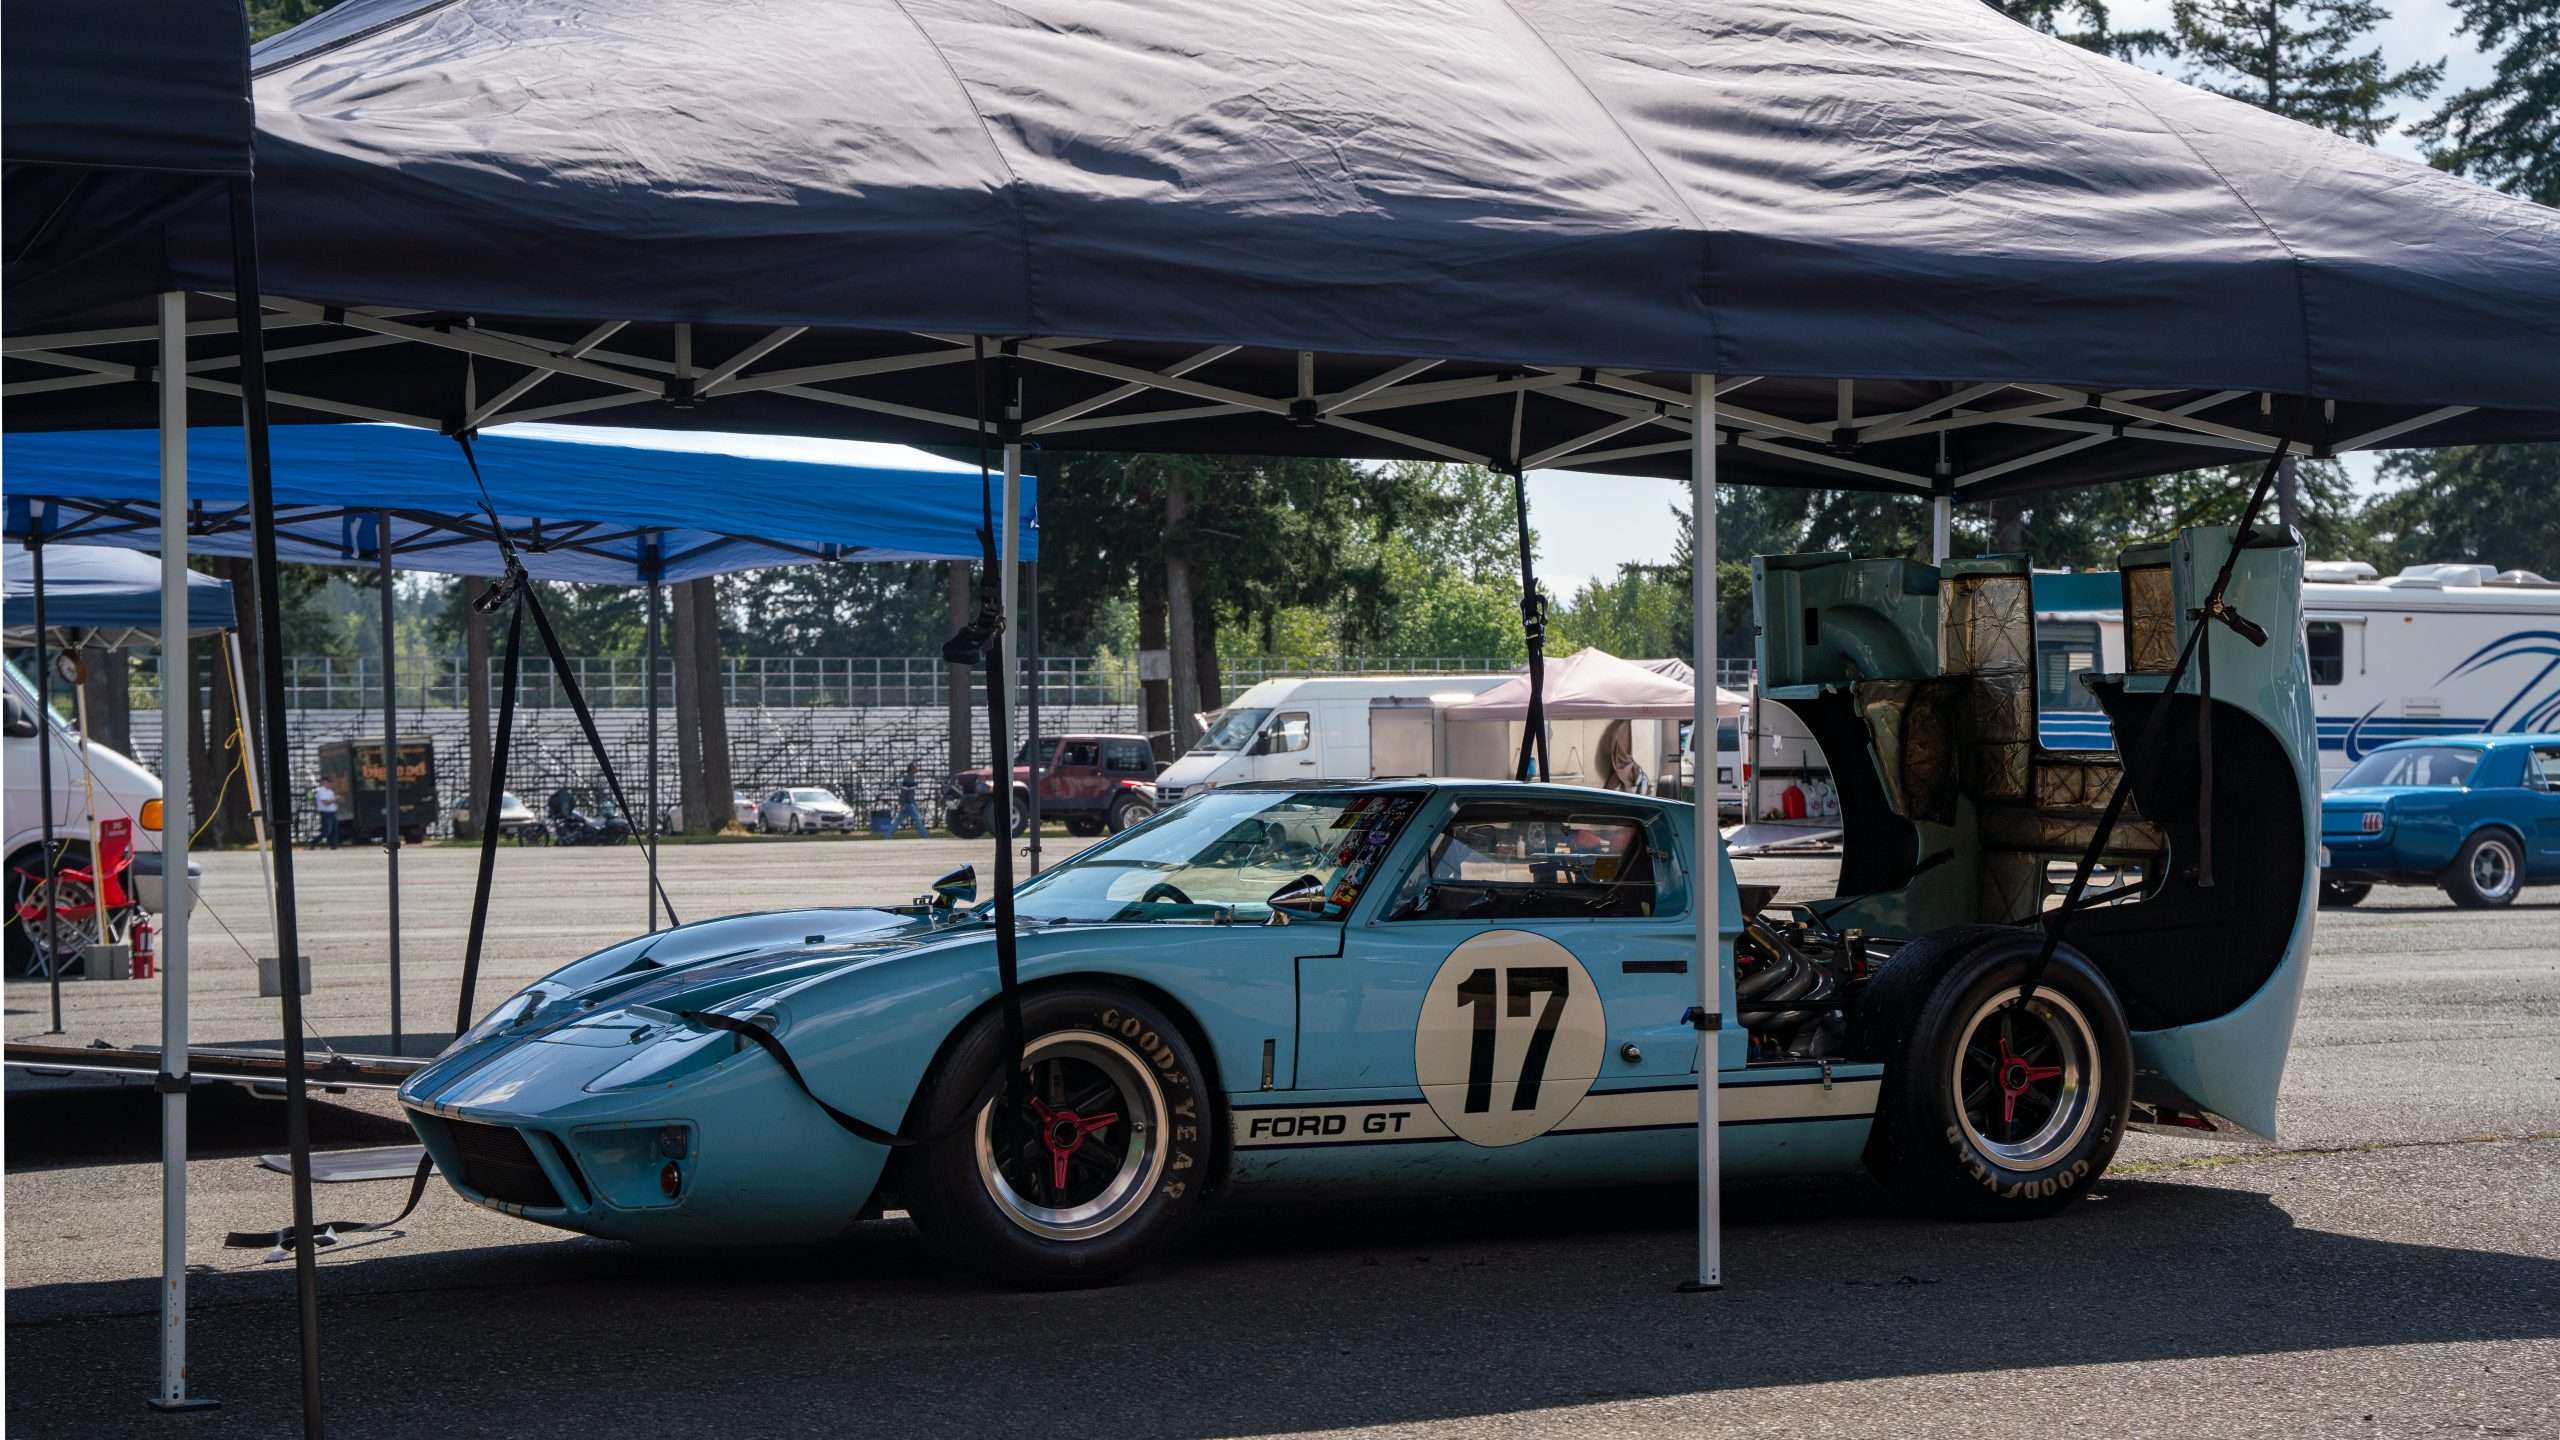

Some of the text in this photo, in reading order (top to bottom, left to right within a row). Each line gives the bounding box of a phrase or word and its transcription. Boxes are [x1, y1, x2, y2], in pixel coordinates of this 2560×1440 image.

[1457, 966, 1569, 1113] 17
[1102, 1009, 1197, 1199] GOODYEAR
[1250, 1112, 1411, 1138] FORD GT
[1946, 1126, 2090, 1199] GOODYEAR
